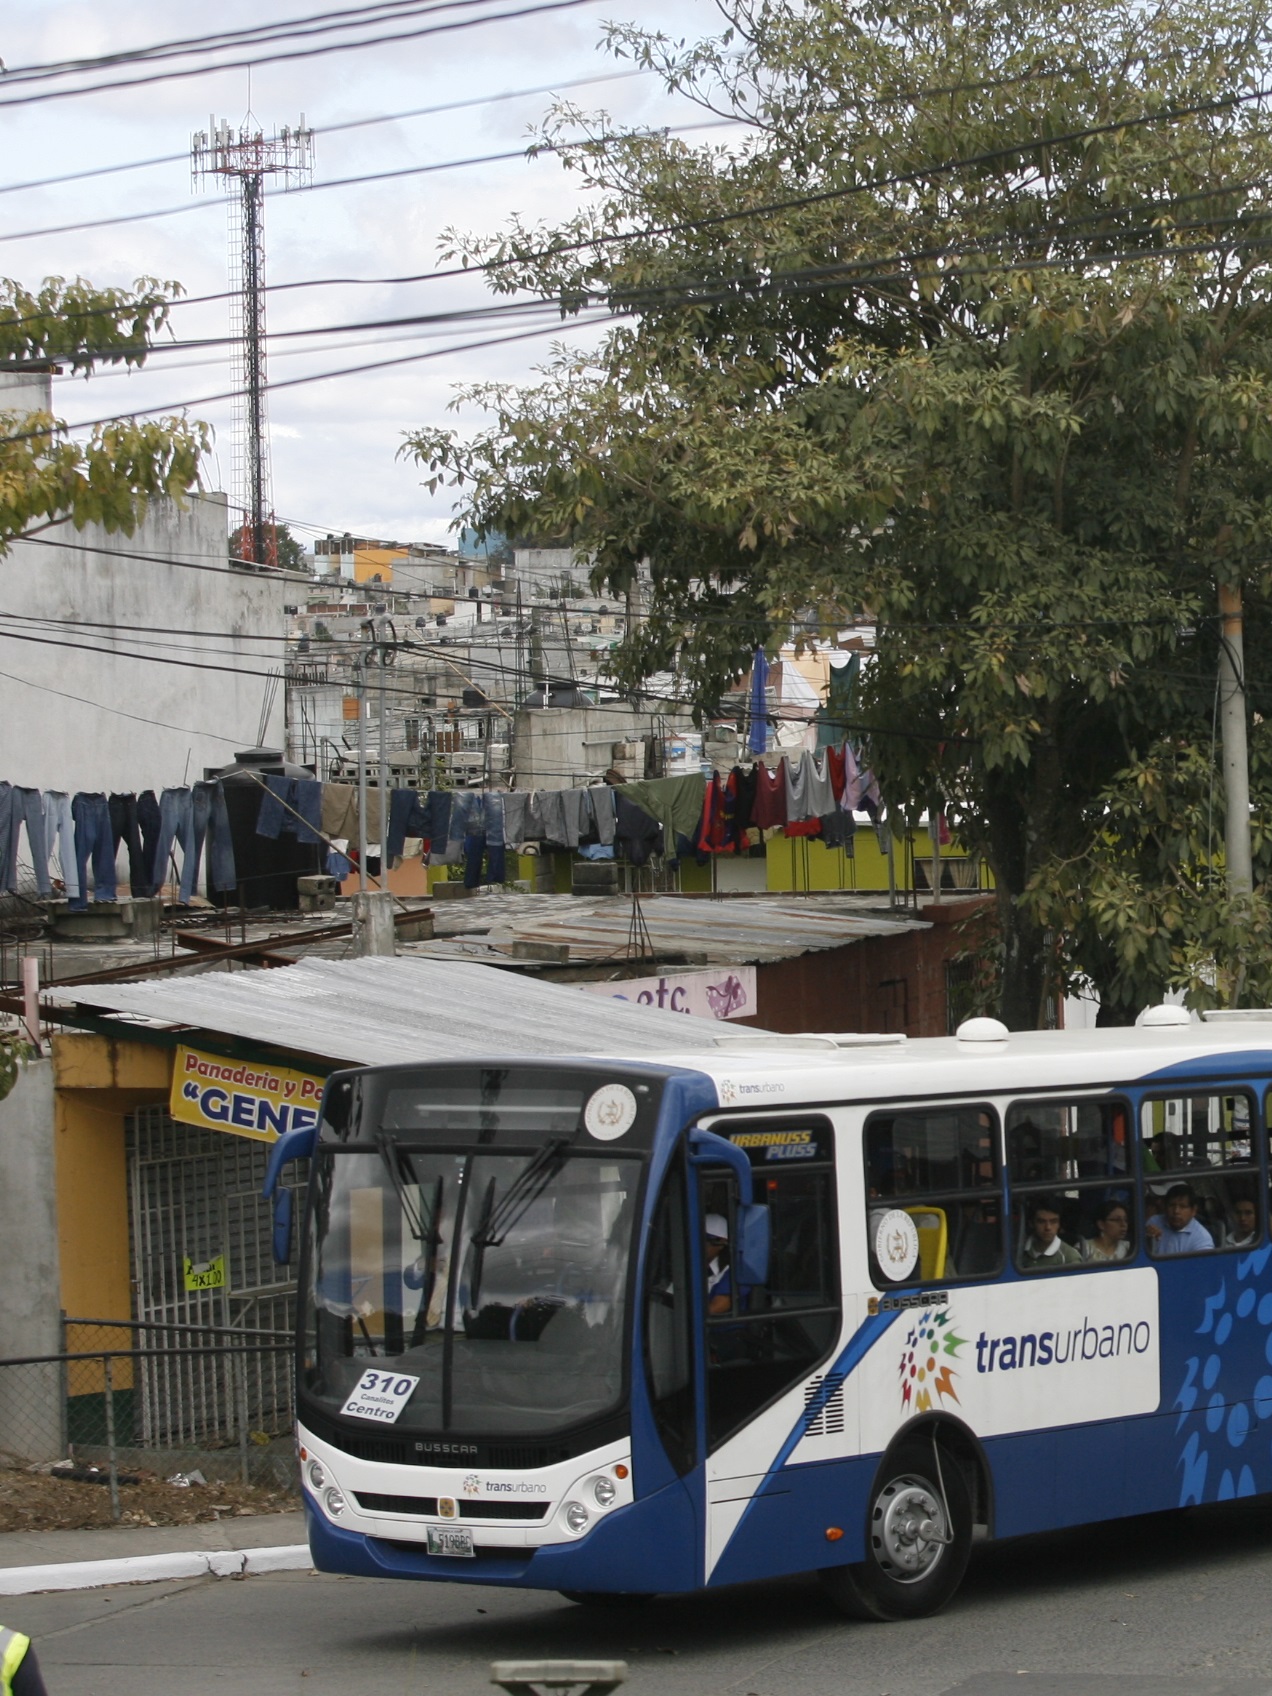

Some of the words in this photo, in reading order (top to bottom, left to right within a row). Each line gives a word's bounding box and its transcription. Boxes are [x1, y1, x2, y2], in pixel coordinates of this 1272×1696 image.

[283, 1080, 297, 1099] y
[739, 1083, 785, 1094] transurbano
[729, 1129, 813, 1148] URBANUSS
[765, 1142, 819, 1160] PLUSS
[975, 1316, 1151, 1374] transurbano
[360, 1373, 412, 1396] 310
[360, 1393, 394, 1405] Canalitos
[346, 1402, 395, 1419] Centro
[415, 1442, 478, 1454] BUSSCAR
[486, 1480, 547, 1493] transurbano
